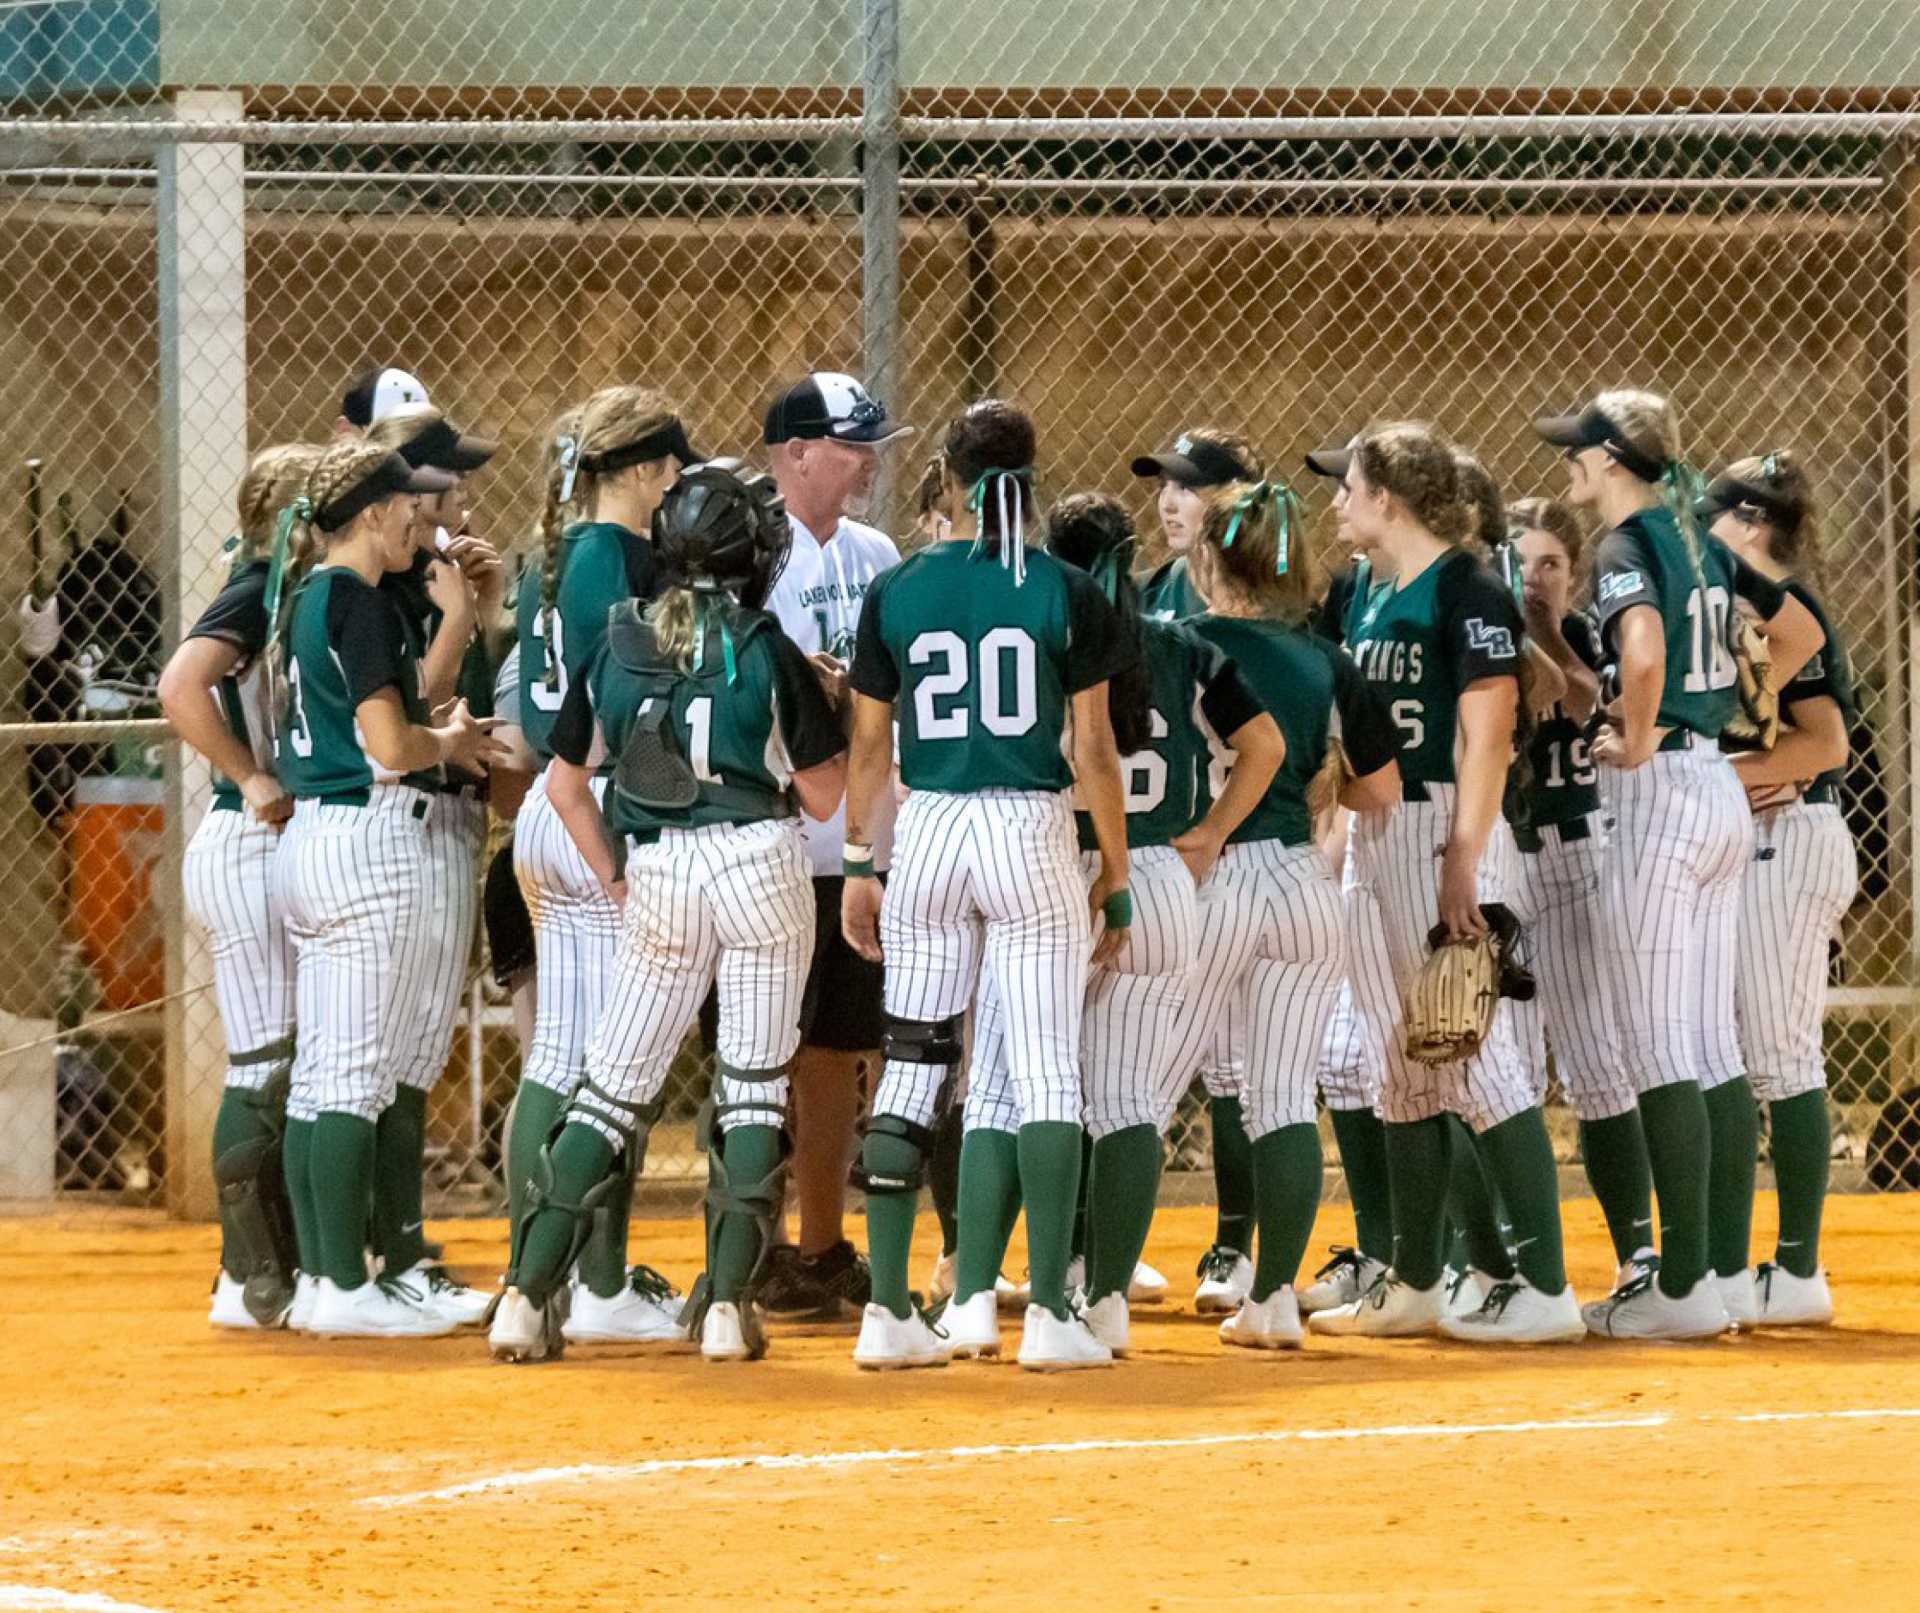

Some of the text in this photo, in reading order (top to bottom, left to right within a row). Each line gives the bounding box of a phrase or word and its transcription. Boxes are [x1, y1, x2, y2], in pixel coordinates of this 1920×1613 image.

[530, 607, 569, 711] 3
[908, 627, 1038, 740] 20
[1464, 617, 1516, 659] LR
[1684, 586, 1738, 692] 10
